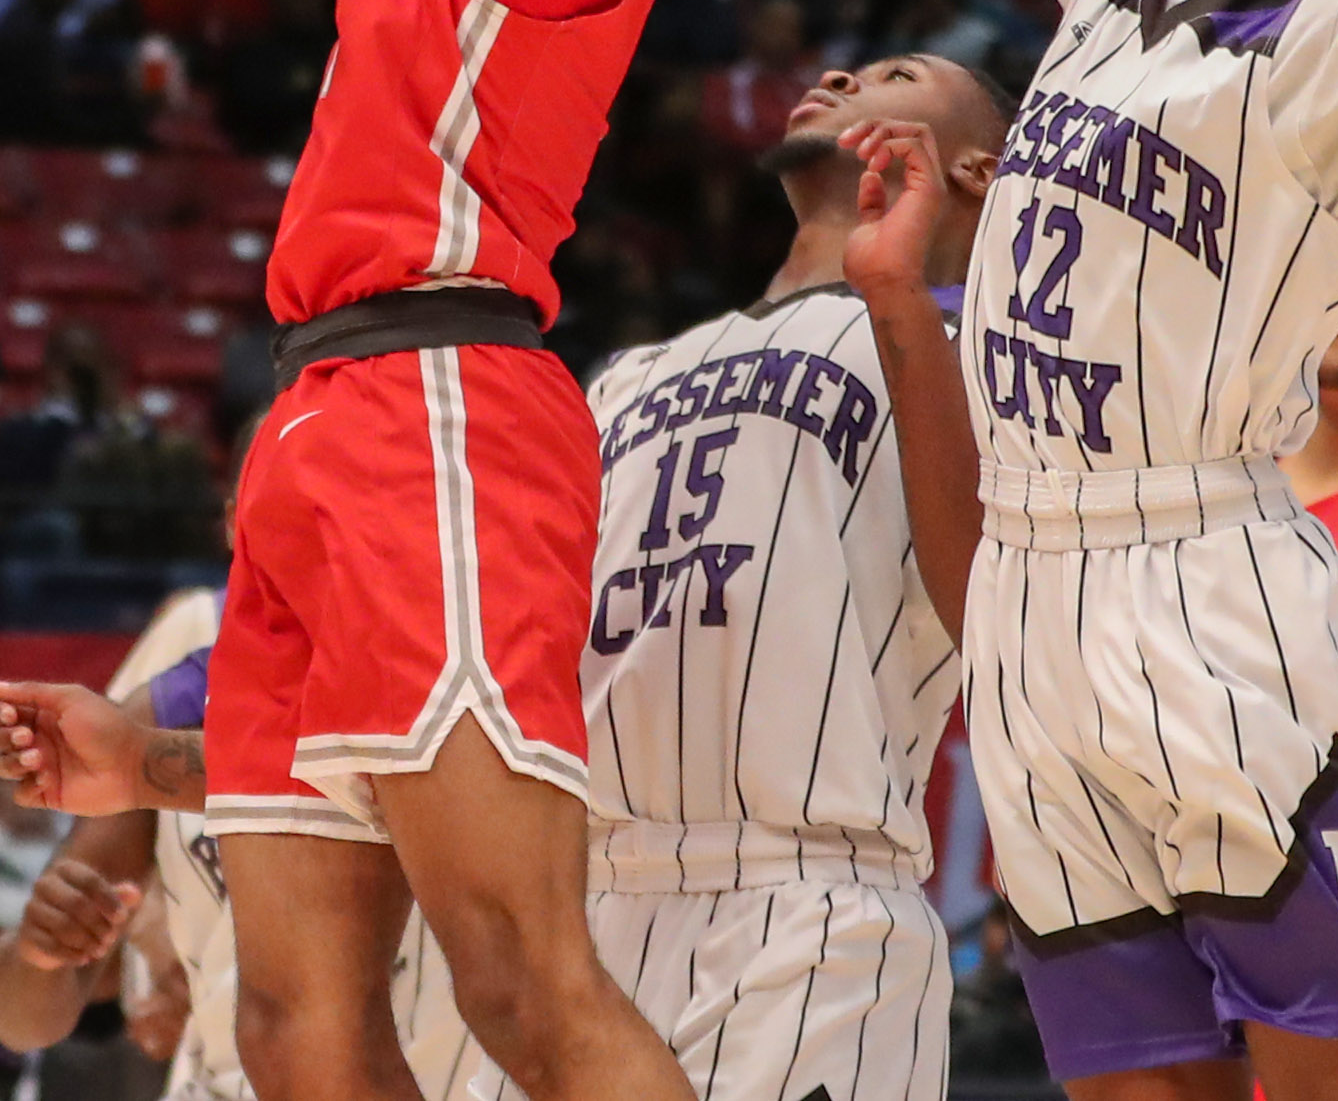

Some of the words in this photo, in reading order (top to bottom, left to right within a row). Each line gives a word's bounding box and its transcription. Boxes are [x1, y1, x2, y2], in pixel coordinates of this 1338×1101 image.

[995, 89, 1226, 282] ESSEMER
[1008, 197, 1083, 341] 12
[601, 348, 878, 490] ESSEMER
[985, 328, 1123, 453] CITY
[638, 426, 740, 551] 15
[591, 543, 755, 656] CITY
